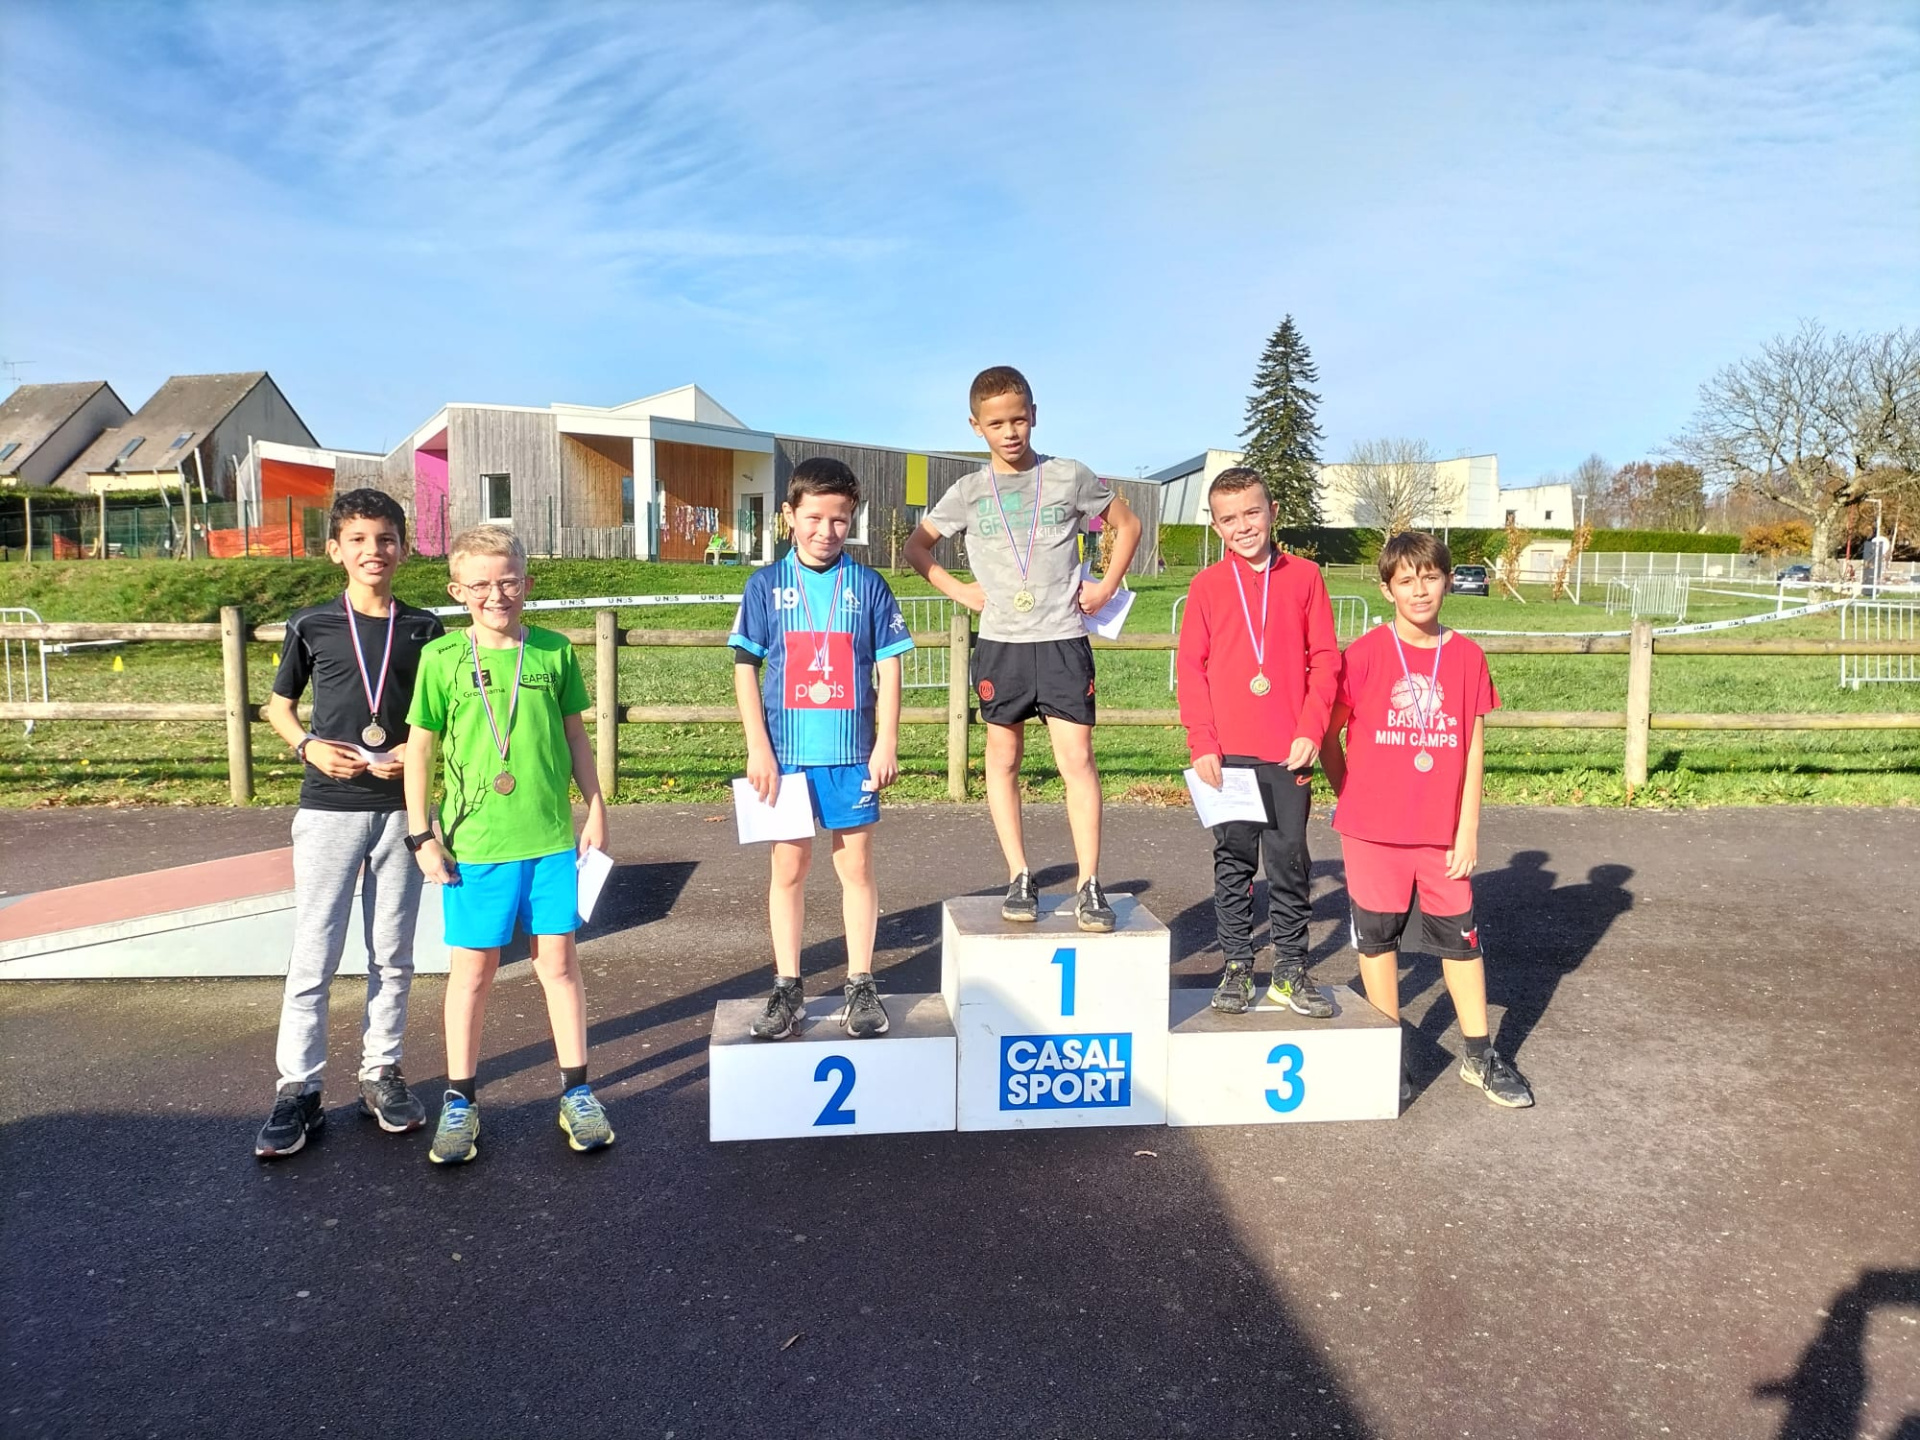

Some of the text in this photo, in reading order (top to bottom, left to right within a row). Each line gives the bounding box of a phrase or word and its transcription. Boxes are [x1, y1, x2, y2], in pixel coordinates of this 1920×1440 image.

[772, 586, 801, 611] 19
[807, 641, 834, 680] 4
[795, 681, 845, 701] pids
[1387, 709, 1435, 729] BASKT
[1375, 730, 1458, 748] MINI CAMPS
[1051, 947, 1077, 1016] 1
[1007, 1038, 1126, 1072] CASAL
[813, 1055, 856, 1126] 2
[1007, 1071, 1125, 1105] SPORT
[1265, 1043, 1305, 1113] 3
